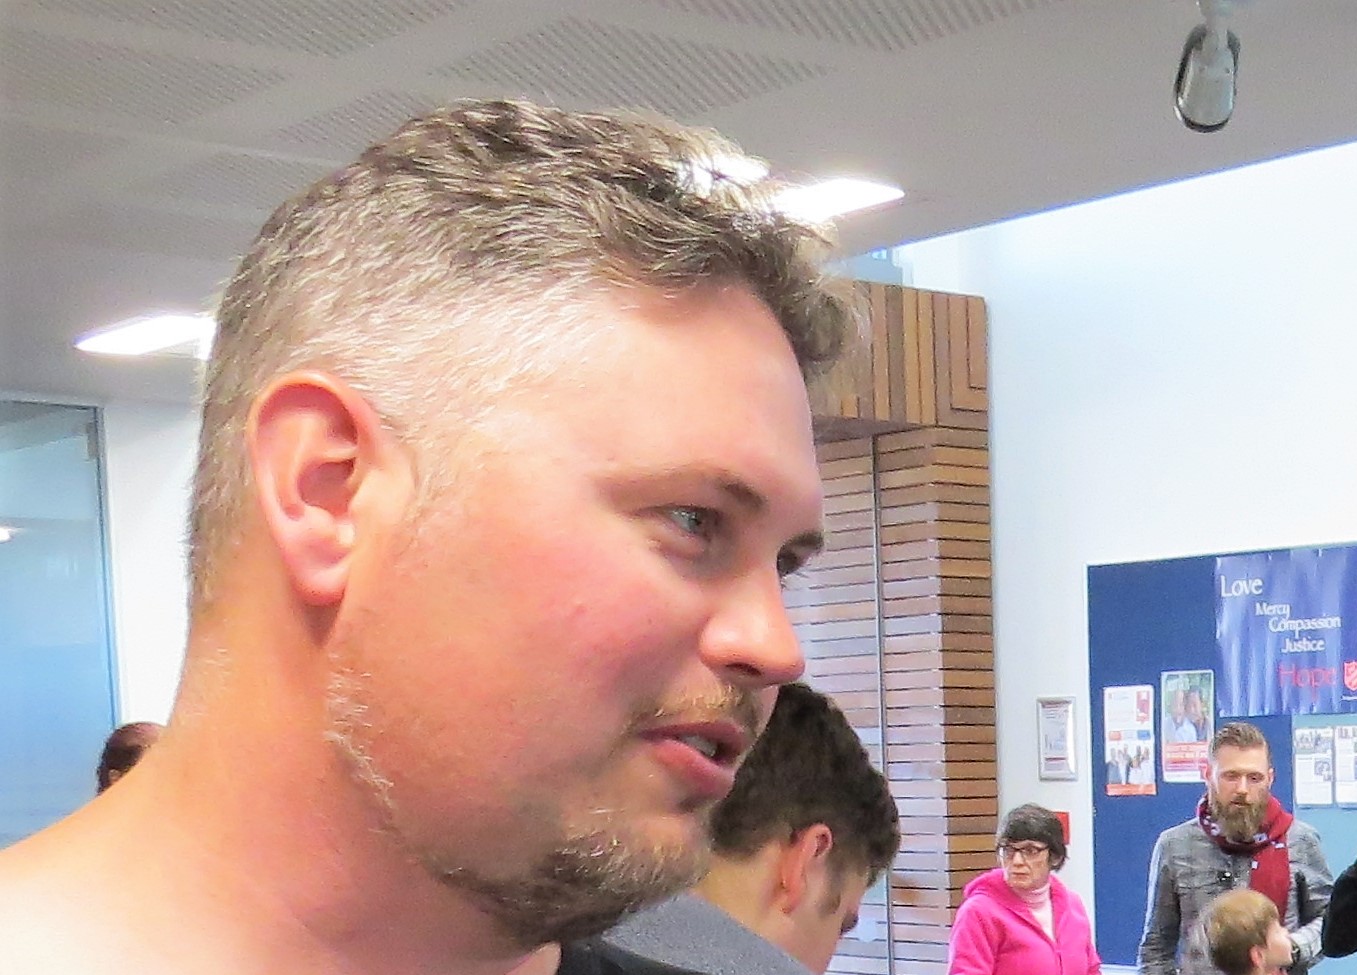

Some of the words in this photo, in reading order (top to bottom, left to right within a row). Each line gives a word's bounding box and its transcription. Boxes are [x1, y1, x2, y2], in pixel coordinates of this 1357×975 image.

[1221, 575, 1263, 597] Love
[1255, 603, 1291, 620] Mercy
[1268, 613, 1342, 638] Compassion
[1281, 637, 1325, 653] Justice
